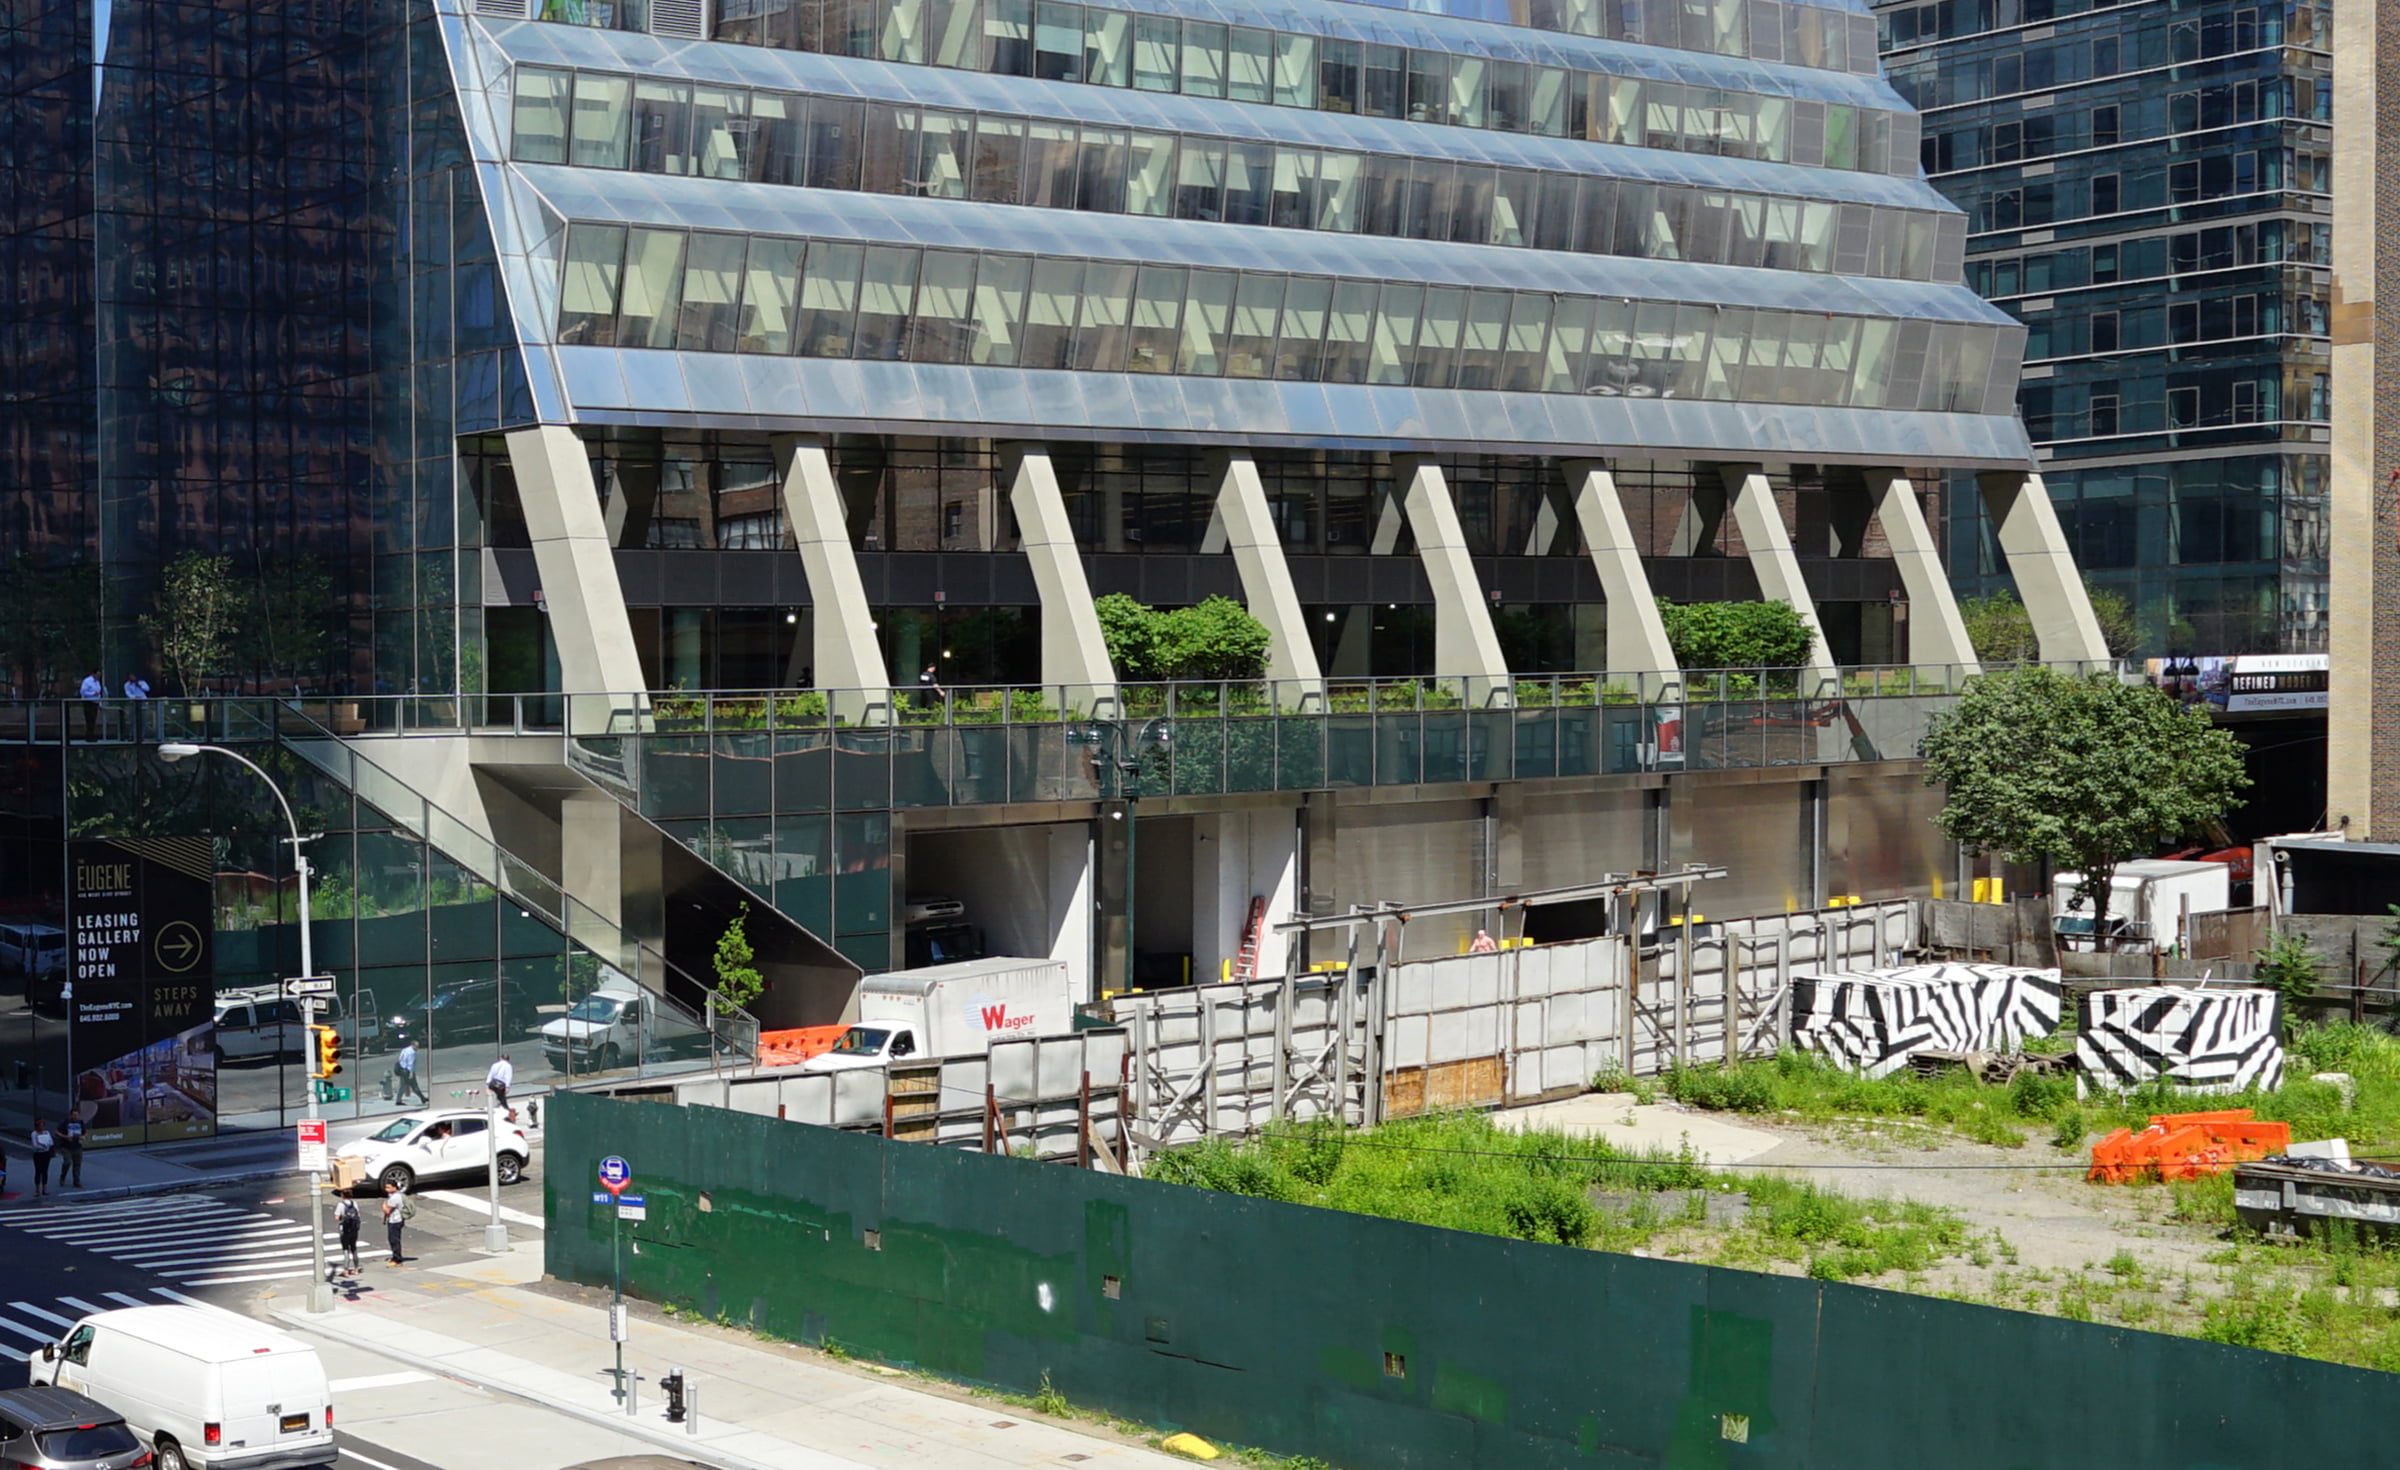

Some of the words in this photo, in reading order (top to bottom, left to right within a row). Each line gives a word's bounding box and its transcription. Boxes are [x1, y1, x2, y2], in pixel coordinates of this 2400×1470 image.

[2232, 675, 2276, 690] REFINED
[77, 863, 132, 891] EUGENE
[77, 913, 138, 929] LEASING
[78, 929, 140, 945] GALLERY
[78, 947, 110, 962] NOW
[78, 963, 115, 979] OPEN
[313, 981, 328, 989] WAY
[154, 986, 198, 1001] STEPS
[154, 1002, 192, 1017] AWAY
[981, 1003, 1036, 1031] Wager
